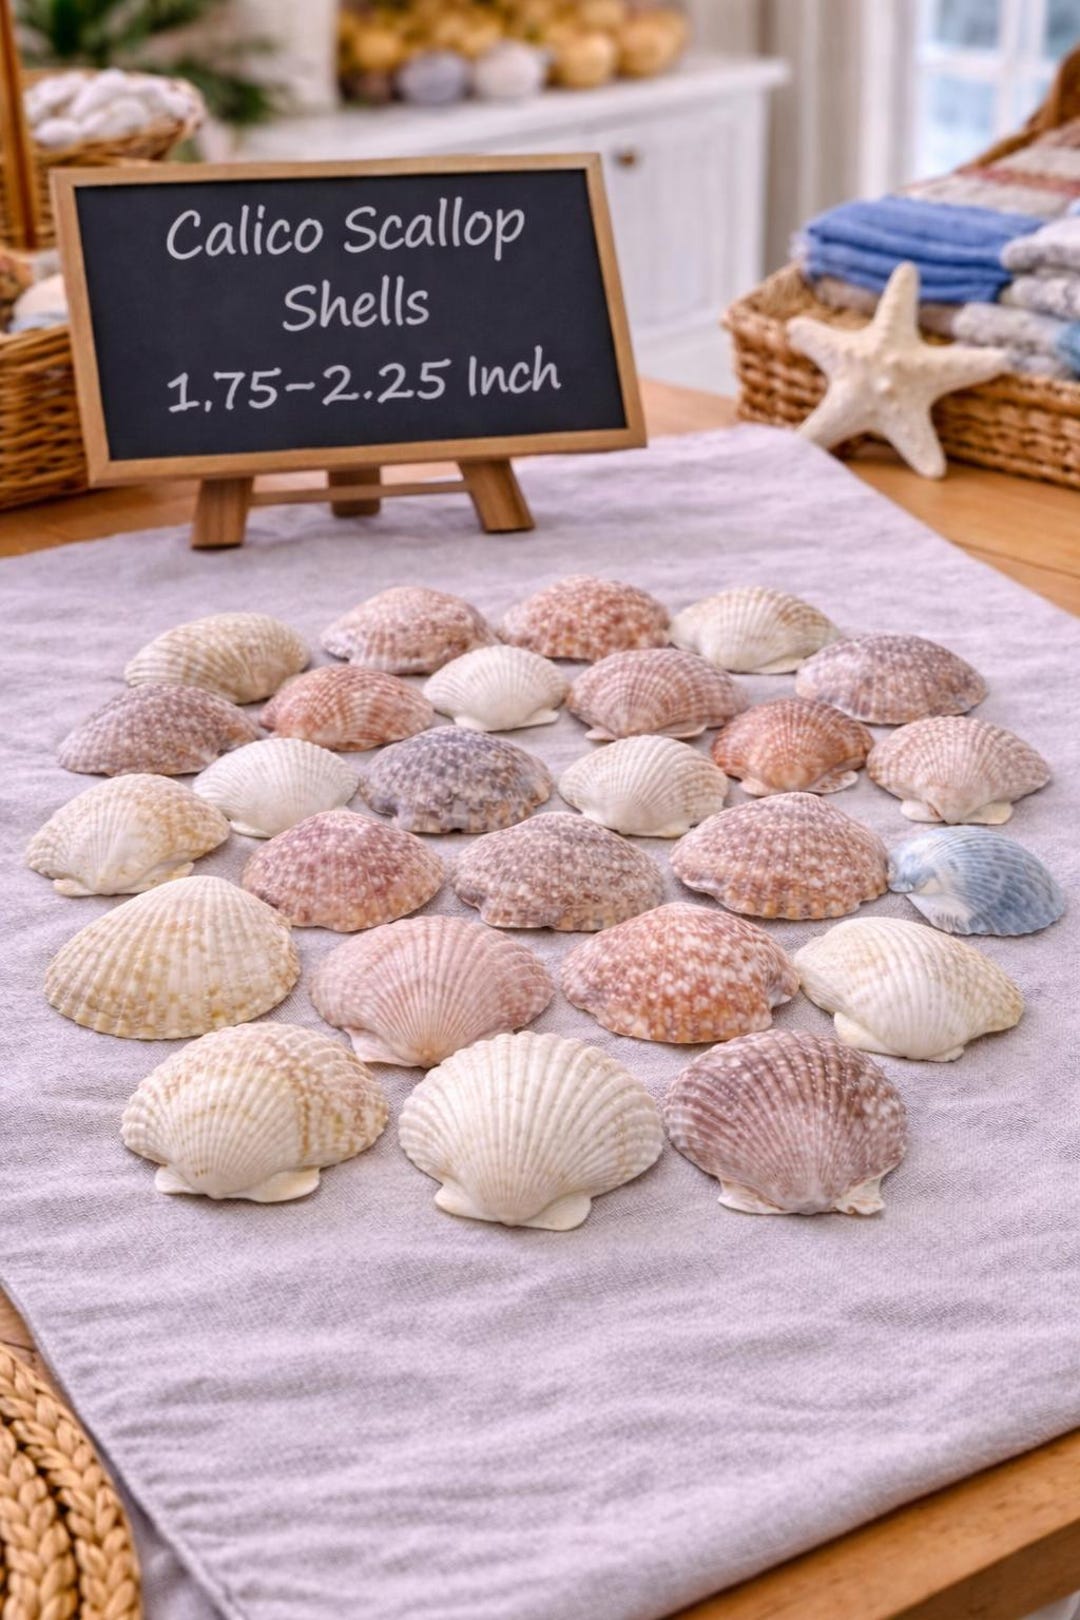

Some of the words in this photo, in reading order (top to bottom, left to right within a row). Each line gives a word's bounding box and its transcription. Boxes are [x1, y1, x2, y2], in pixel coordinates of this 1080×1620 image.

[166, 204, 324, 260] Calico
[344, 197, 525, 261] Scallop
[282, 275, 429, 332] Shells
[167, 358, 451, 414] 1.75-2.25
[468, 345, 562, 398] Inch
